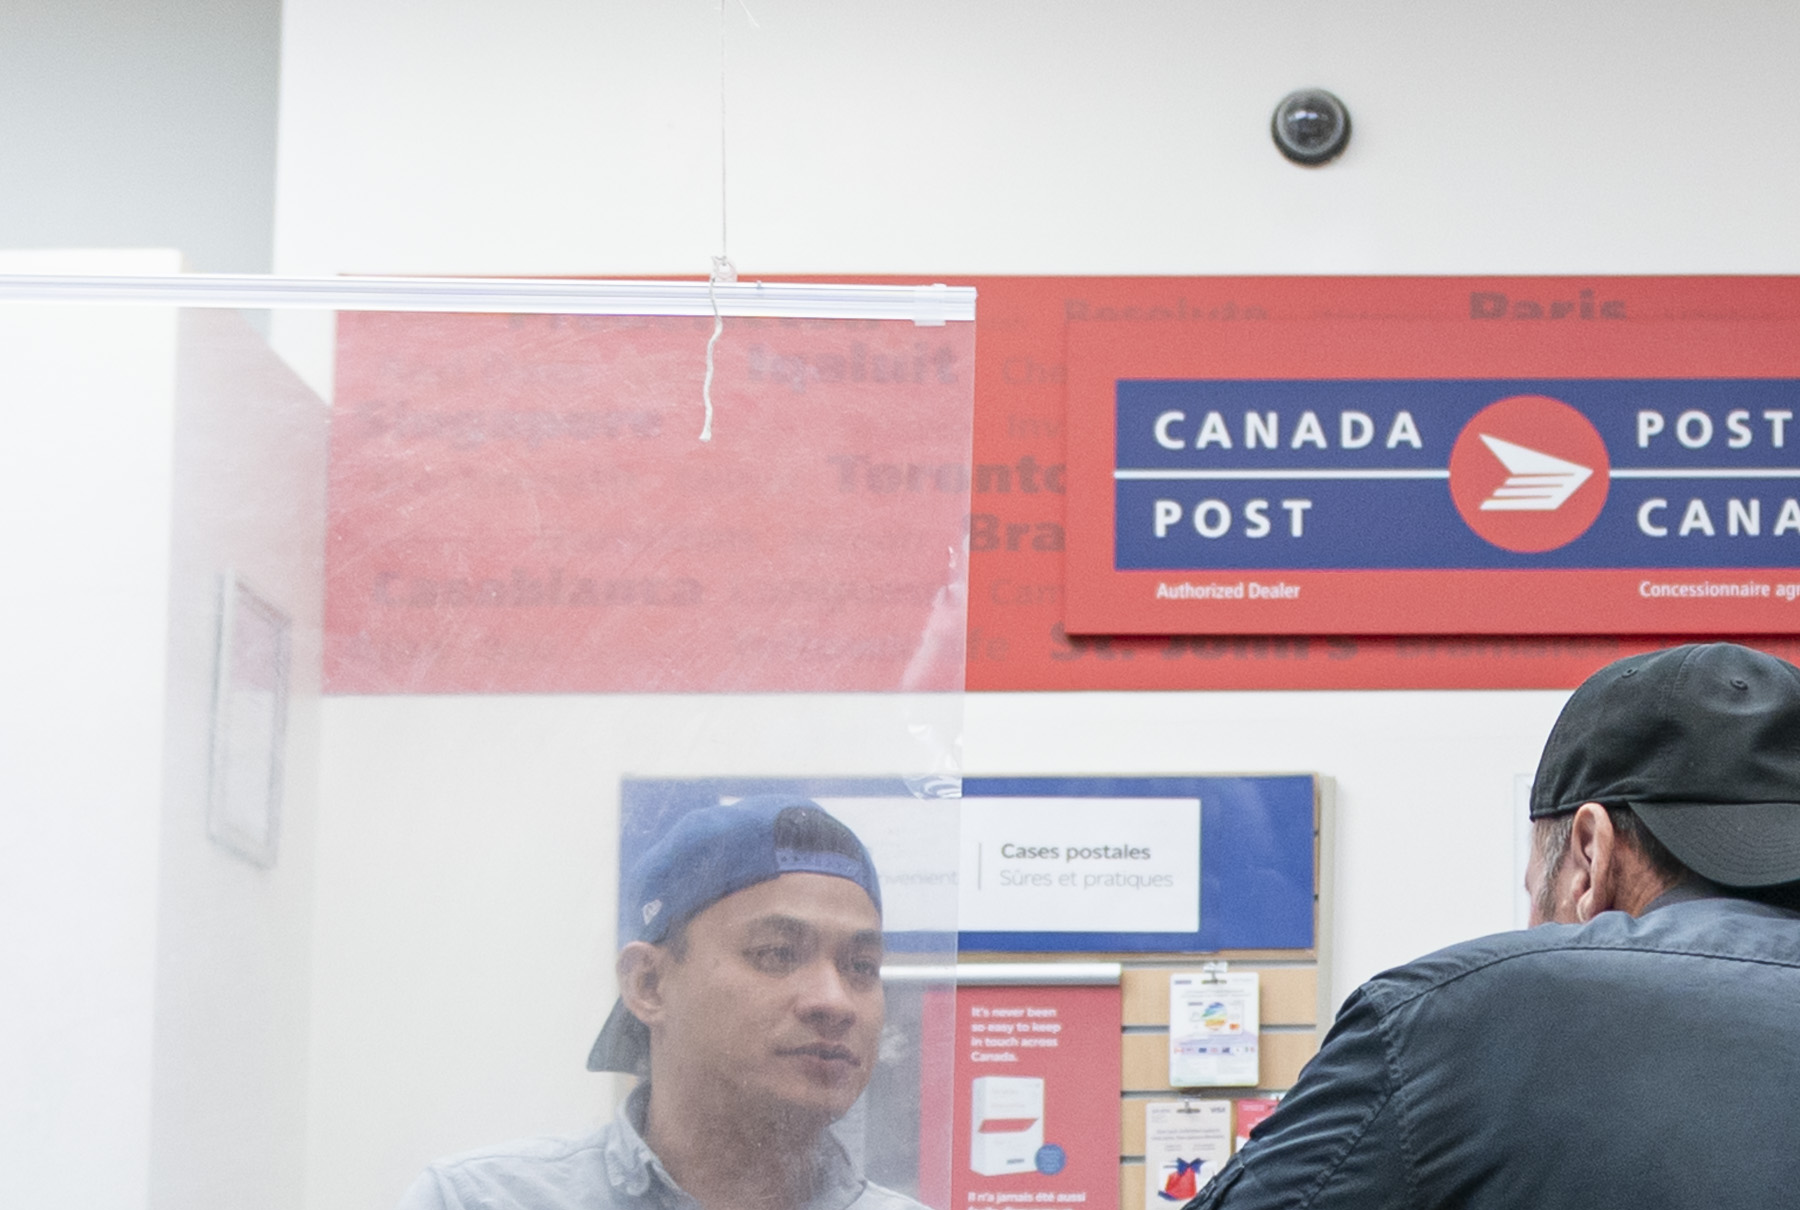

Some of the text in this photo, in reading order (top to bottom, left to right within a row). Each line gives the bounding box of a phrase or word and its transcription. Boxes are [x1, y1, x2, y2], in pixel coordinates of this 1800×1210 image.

[1154, 411, 1424, 449] CANADA
[1154, 499, 1313, 538] POST
[1157, 582, 1301, 600] Authorized Dealer
[1639, 581, 1770, 599] Concessionnaire
[1001, 843, 1152, 864] Cases postales
[999, 868, 1174, 890] Sûres et pratiques
